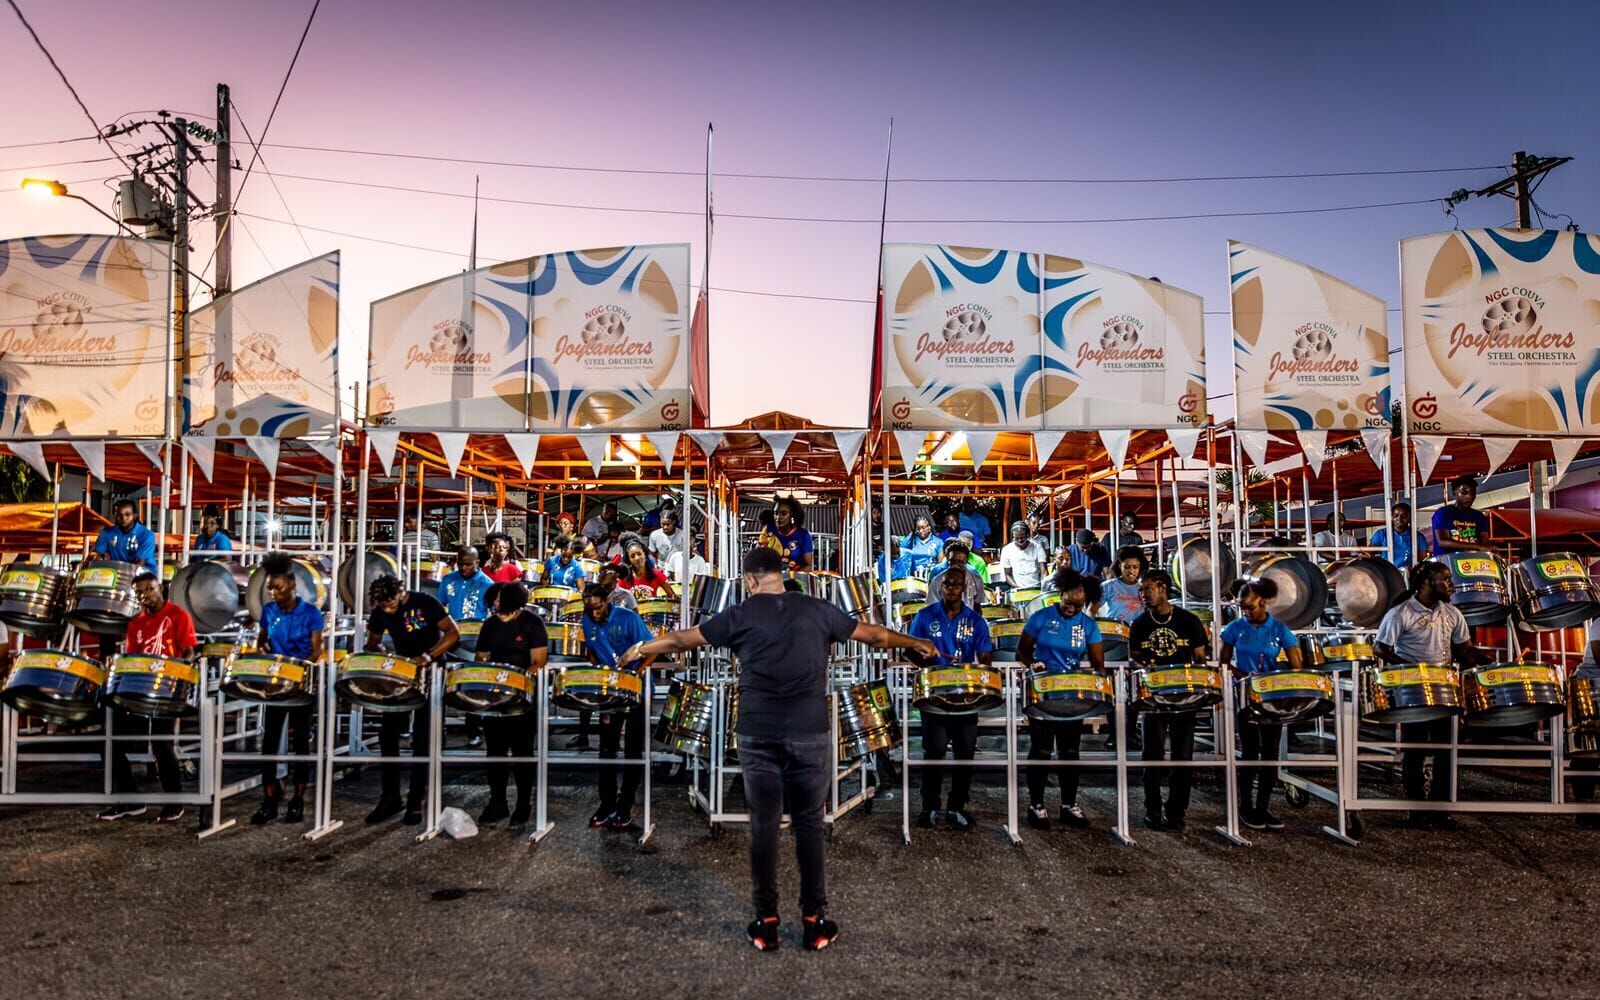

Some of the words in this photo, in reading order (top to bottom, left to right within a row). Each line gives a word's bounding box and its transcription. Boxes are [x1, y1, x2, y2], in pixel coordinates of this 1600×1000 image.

[1485, 287, 1509, 304] NGC
[1512, 287, 1545, 309] COUVA
[585, 305, 604, 319] NGC
[606, 304, 632, 322] COUVA
[946, 304, 965, 318] NGC
[967, 303, 992, 321] COUVA
[434, 320, 450, 331] NGC
[452, 319, 474, 335] COUVA
[1103, 316, 1120, 329] NGC
[1121, 315, 1144, 330] COUVA
[1295, 323, 1312, 336] NGC
[1314, 322, 1338, 339] COUVA
[914, 332, 1015, 362] Joylanders
[1447, 322, 1576, 359] Joylanders
[405, 344, 493, 370] Joylanders
[553, 334, 654, 365] Joylanders
[1076, 342, 1164, 368] Joylanders
[1487, 352, 1513, 360] STEEL
[1518, 352, 1576, 360] ORCHESTRA
[1268, 351, 1360, 381] Joylanders
[375, 417, 397, 425] NGC
[661, 423, 681, 431] NGC
[892, 422, 912, 430] NGC
[1177, 415, 1198, 423] NGC
[1365, 418, 1387, 426] NGC
[1413, 422, 1441, 431] NGC
